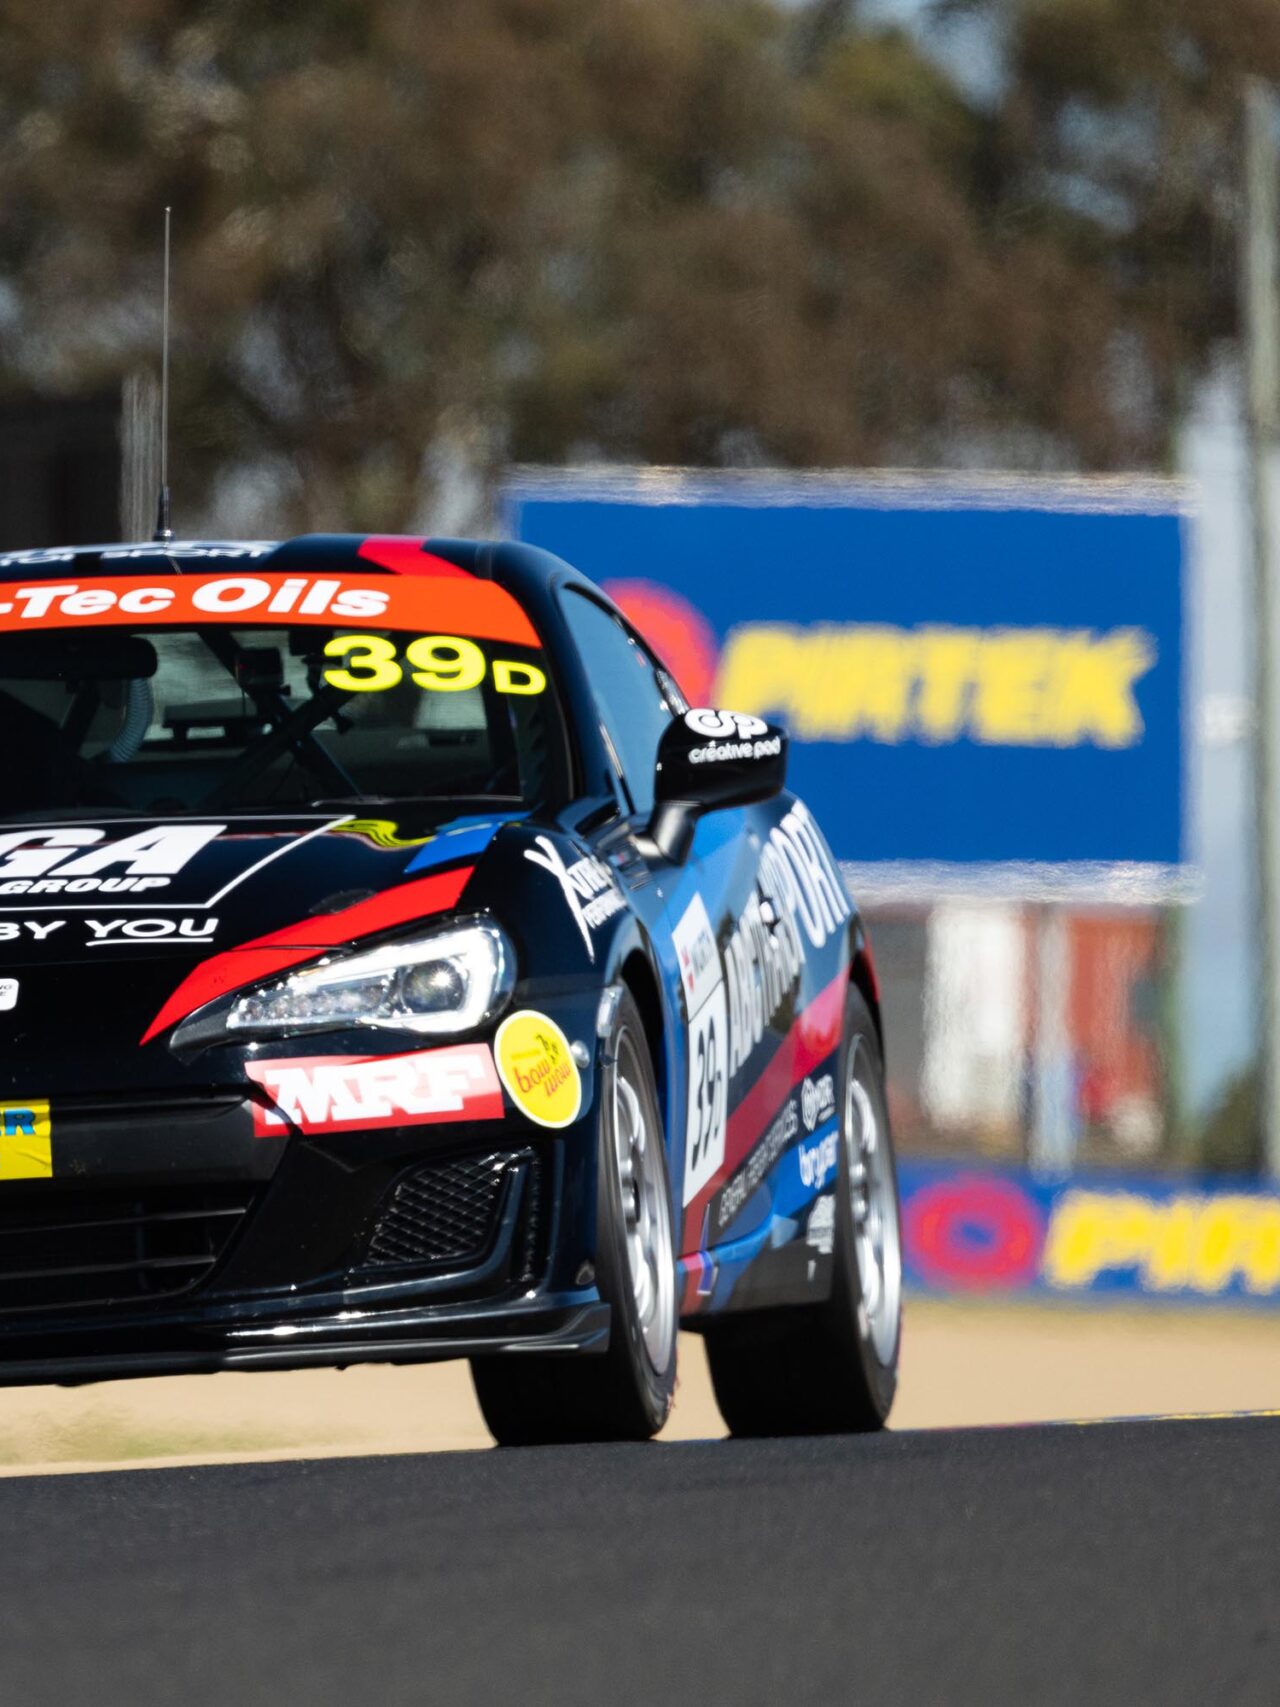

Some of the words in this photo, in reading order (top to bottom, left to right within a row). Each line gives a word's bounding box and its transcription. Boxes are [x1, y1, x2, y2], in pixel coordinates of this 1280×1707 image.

[192, 578, 390, 617] Oils
[84, 918, 219, 941] YOU
[264, 1054, 486, 1126] MRF
[513, 1060, 551, 1093] bow
